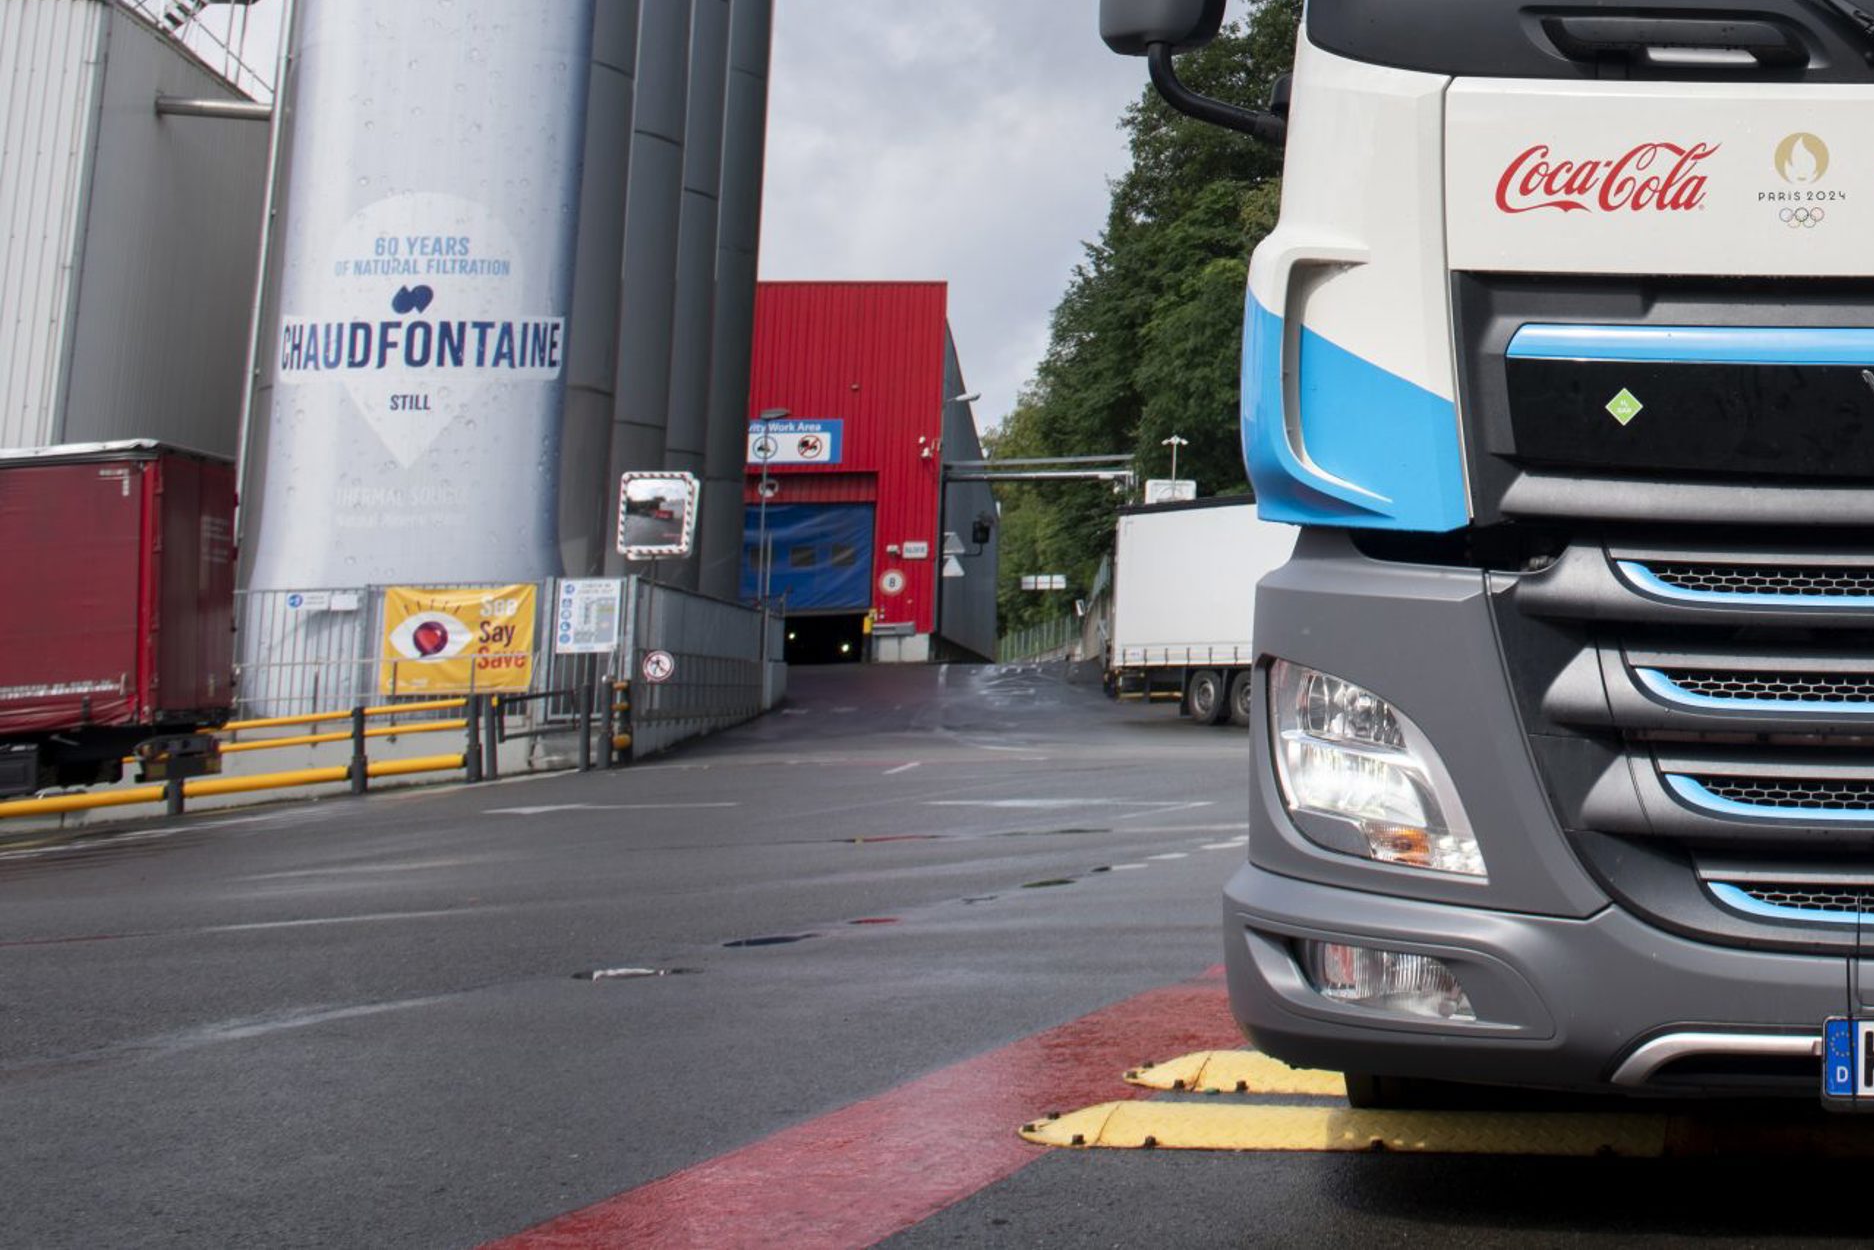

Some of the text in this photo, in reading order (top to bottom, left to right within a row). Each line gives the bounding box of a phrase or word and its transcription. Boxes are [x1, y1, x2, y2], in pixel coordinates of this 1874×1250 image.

[1495, 142, 1722, 214] Coca-Cola
[1806, 190, 1846, 201] 2024
[375, 237, 470, 256] 60 YEARS
[335, 259, 510, 276] OF NATURAL FILTRATION
[281, 321, 560, 371] CHAUDFONTAINE
[390, 394, 431, 411] STILL
[768, 422, 795, 431] Work
[797, 422, 822, 431] Area
[480, 595, 518, 618] See
[478, 620, 516, 647] Say
[477, 646, 526, 670] Save
[1836, 1066, 1849, 1083] D
